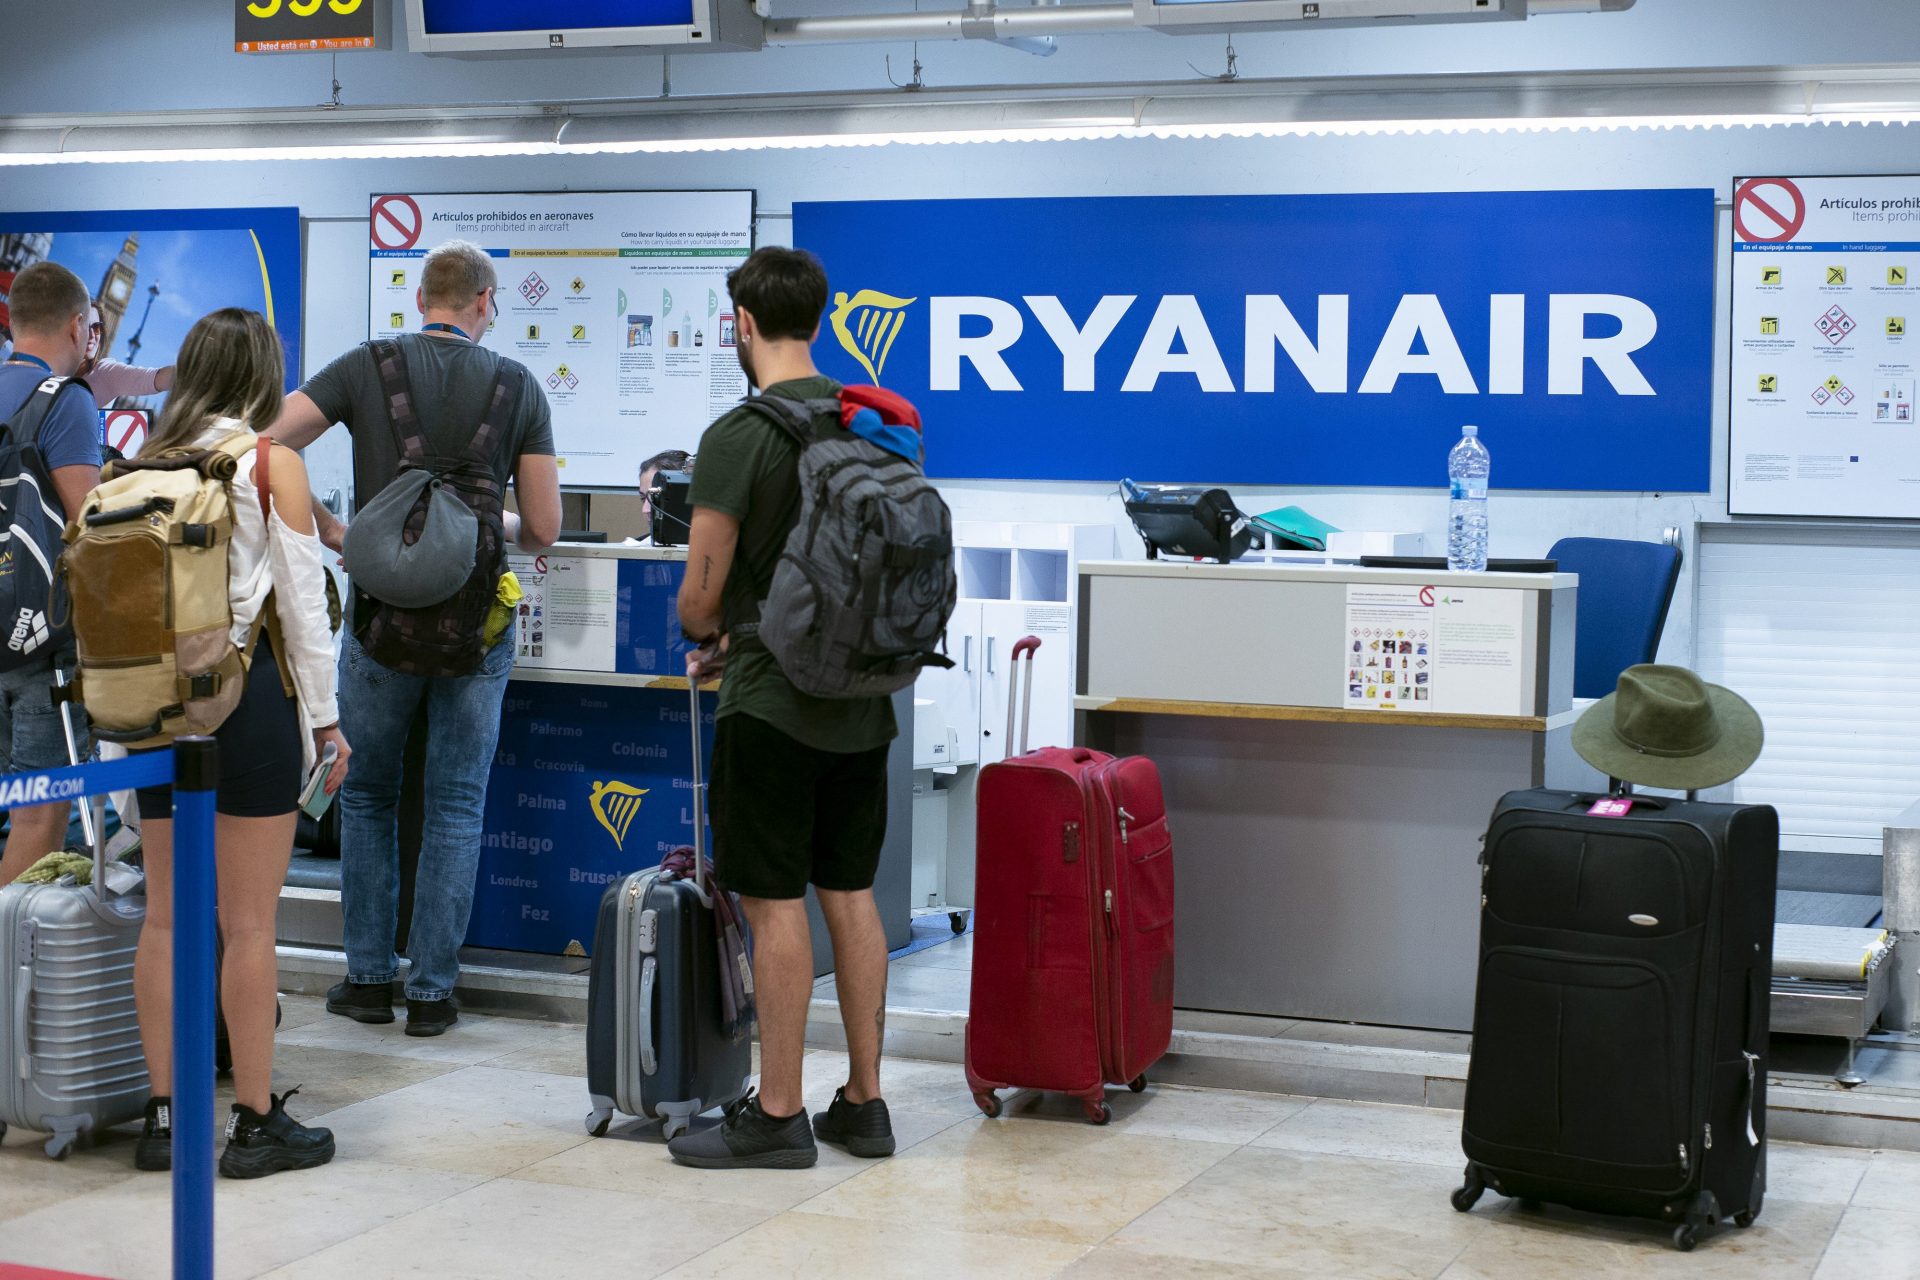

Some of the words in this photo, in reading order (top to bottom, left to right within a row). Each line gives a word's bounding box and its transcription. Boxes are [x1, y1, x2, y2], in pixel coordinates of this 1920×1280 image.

[257, 42, 278, 51] Usted
[281, 41, 296, 50] está
[323, 40, 337, 48] You
[1819, 198, 1877, 209] Artículos
[477, 211, 527, 223] prohibidos
[544, 212, 594, 220] aeronaves
[1852, 211, 1884, 222] Items
[455, 223, 478, 232] Items
[481, 222, 525, 233] prohibited
[528, 222, 536, 231] in
[538, 221, 569, 232] aircraft
[1758, 244, 1785, 252] equipaje
[664, 297, 671, 307] 2
[710, 297, 716, 307] 3
[929, 293, 1659, 396] RYANAIR
[8, 607, 34, 651] arena
[529, 722, 583, 736] Palermo
[611, 741, 668, 758] Colonia
[533, 758, 585, 773] Cracovia
[517, 793, 566, 810] Palma
[490, 874, 538, 888] Londres
[521, 904, 550, 921] Fez
